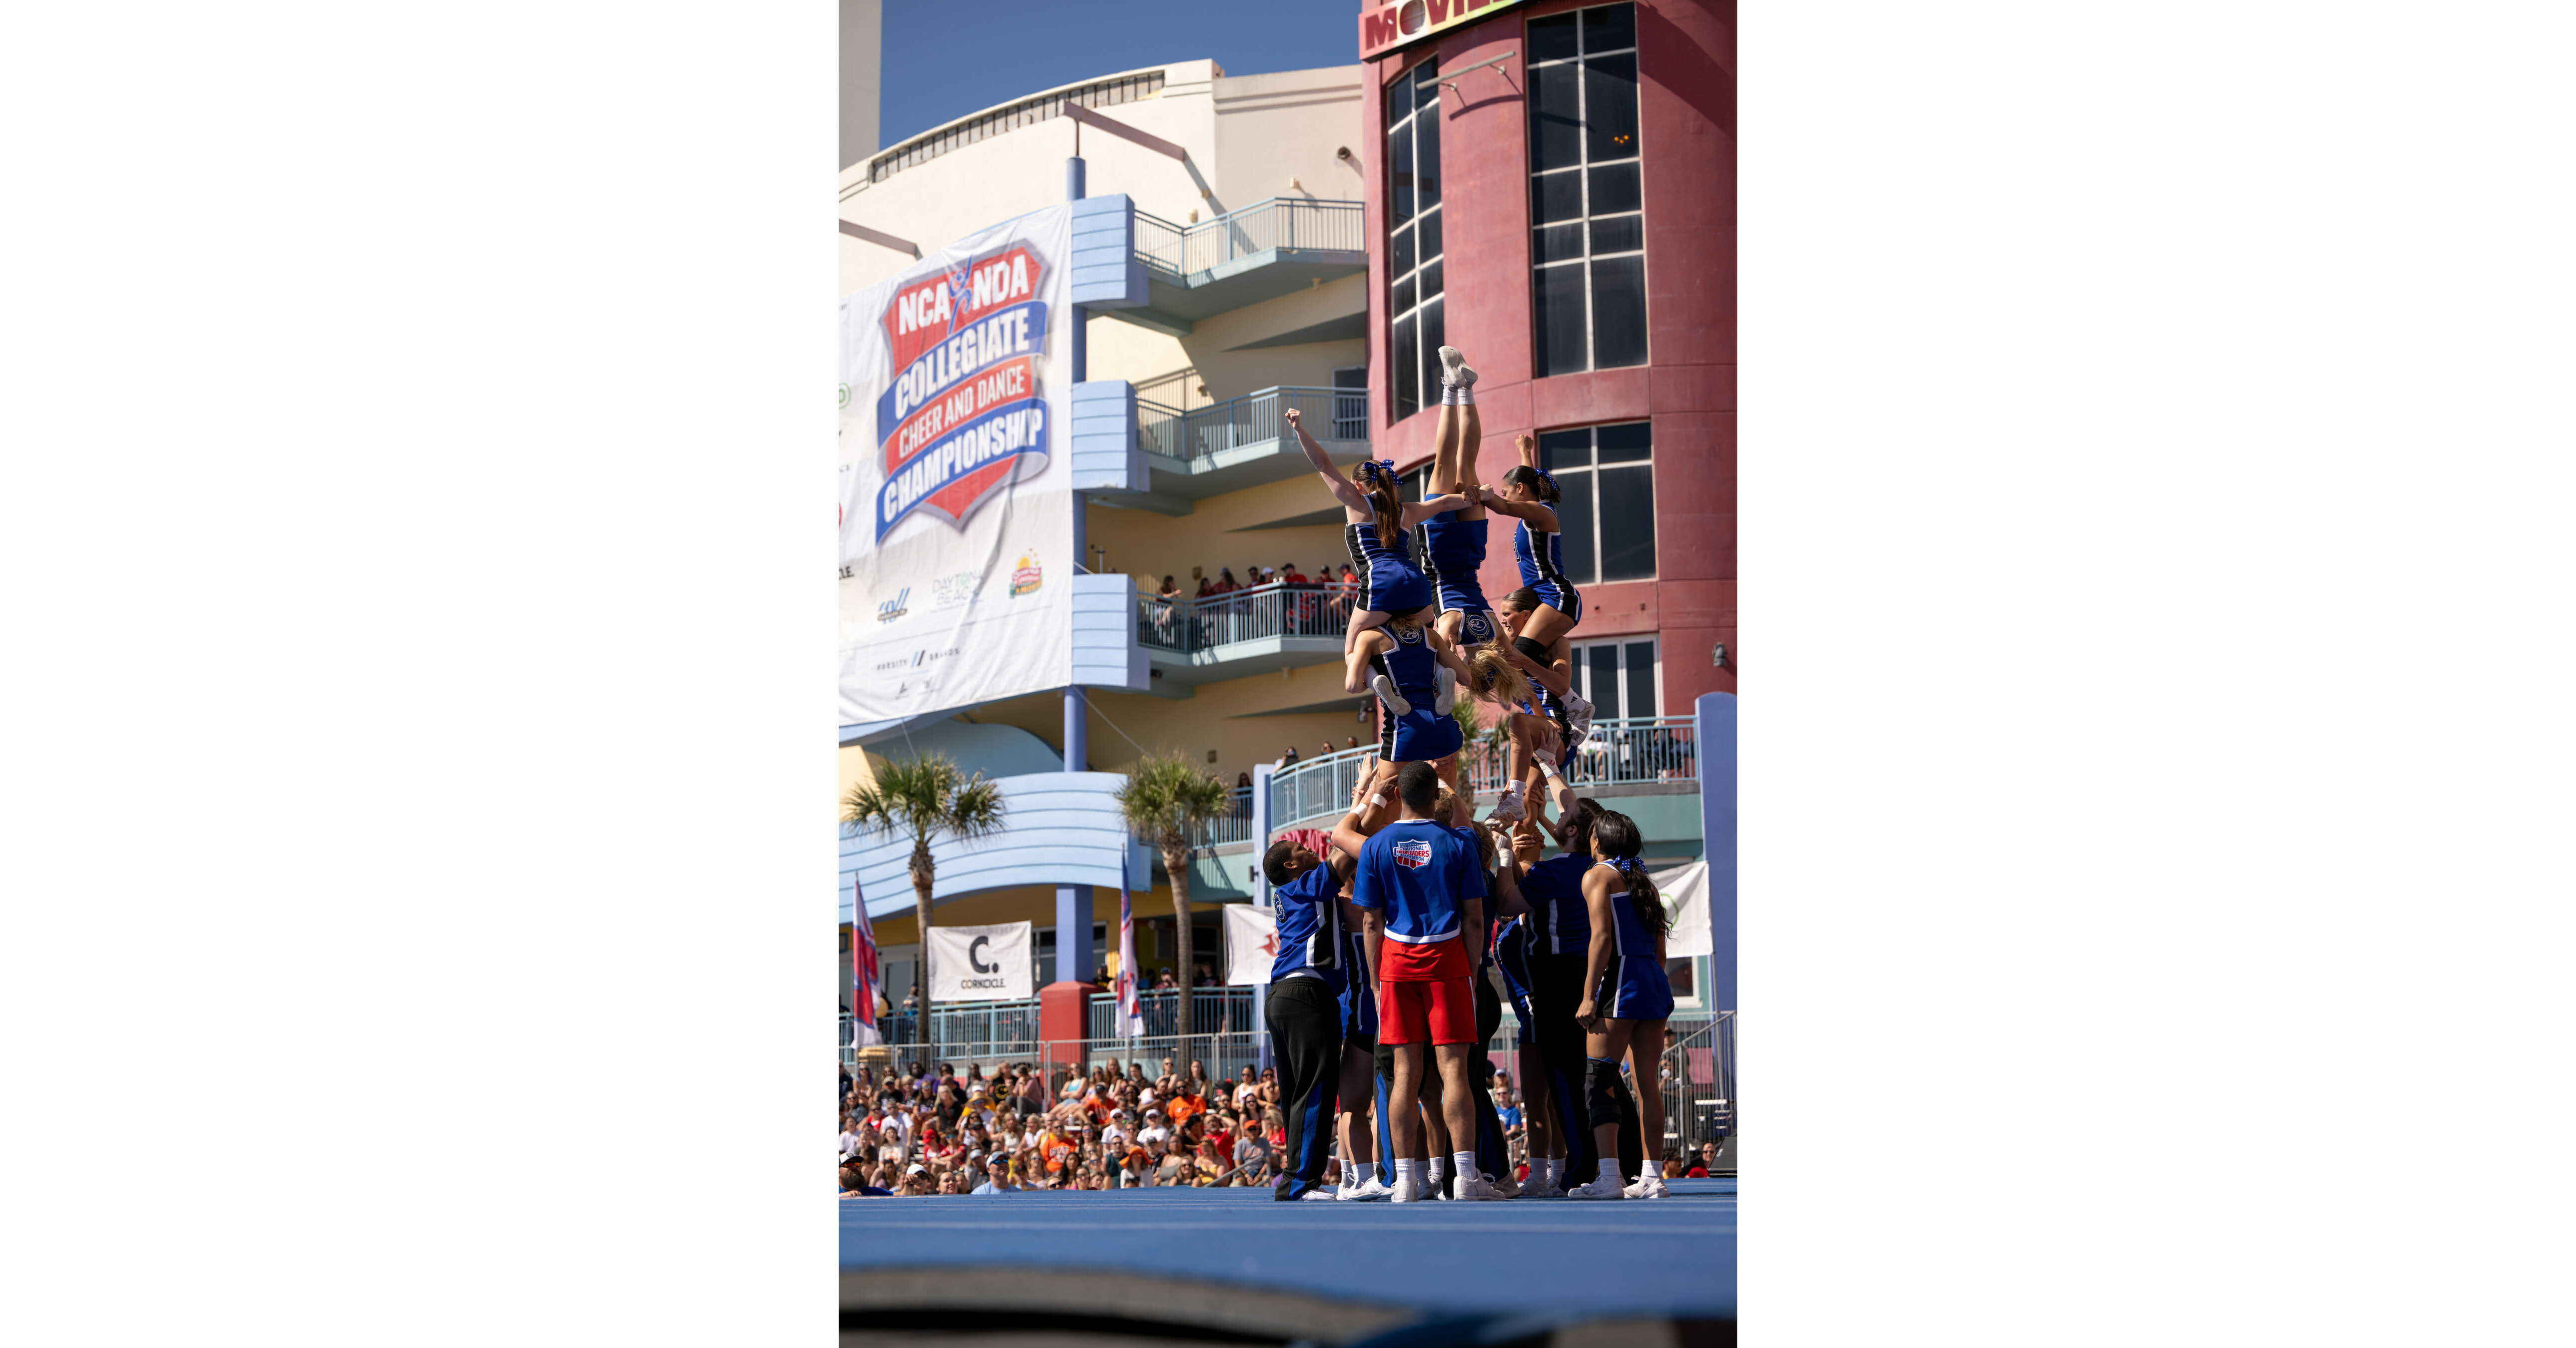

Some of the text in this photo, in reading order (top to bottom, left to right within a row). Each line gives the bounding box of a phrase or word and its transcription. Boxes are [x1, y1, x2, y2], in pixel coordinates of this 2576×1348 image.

[899, 254, 1029, 335] NCA NDA
[895, 307, 1030, 421] COLLEGIATE
[900, 364, 1025, 459] CHEER AND DANCE
[884, 408, 1042, 523] CHAMPIONSHIP
[877, 659, 907, 671] VARSITY
[970, 935, 999, 973] C.
